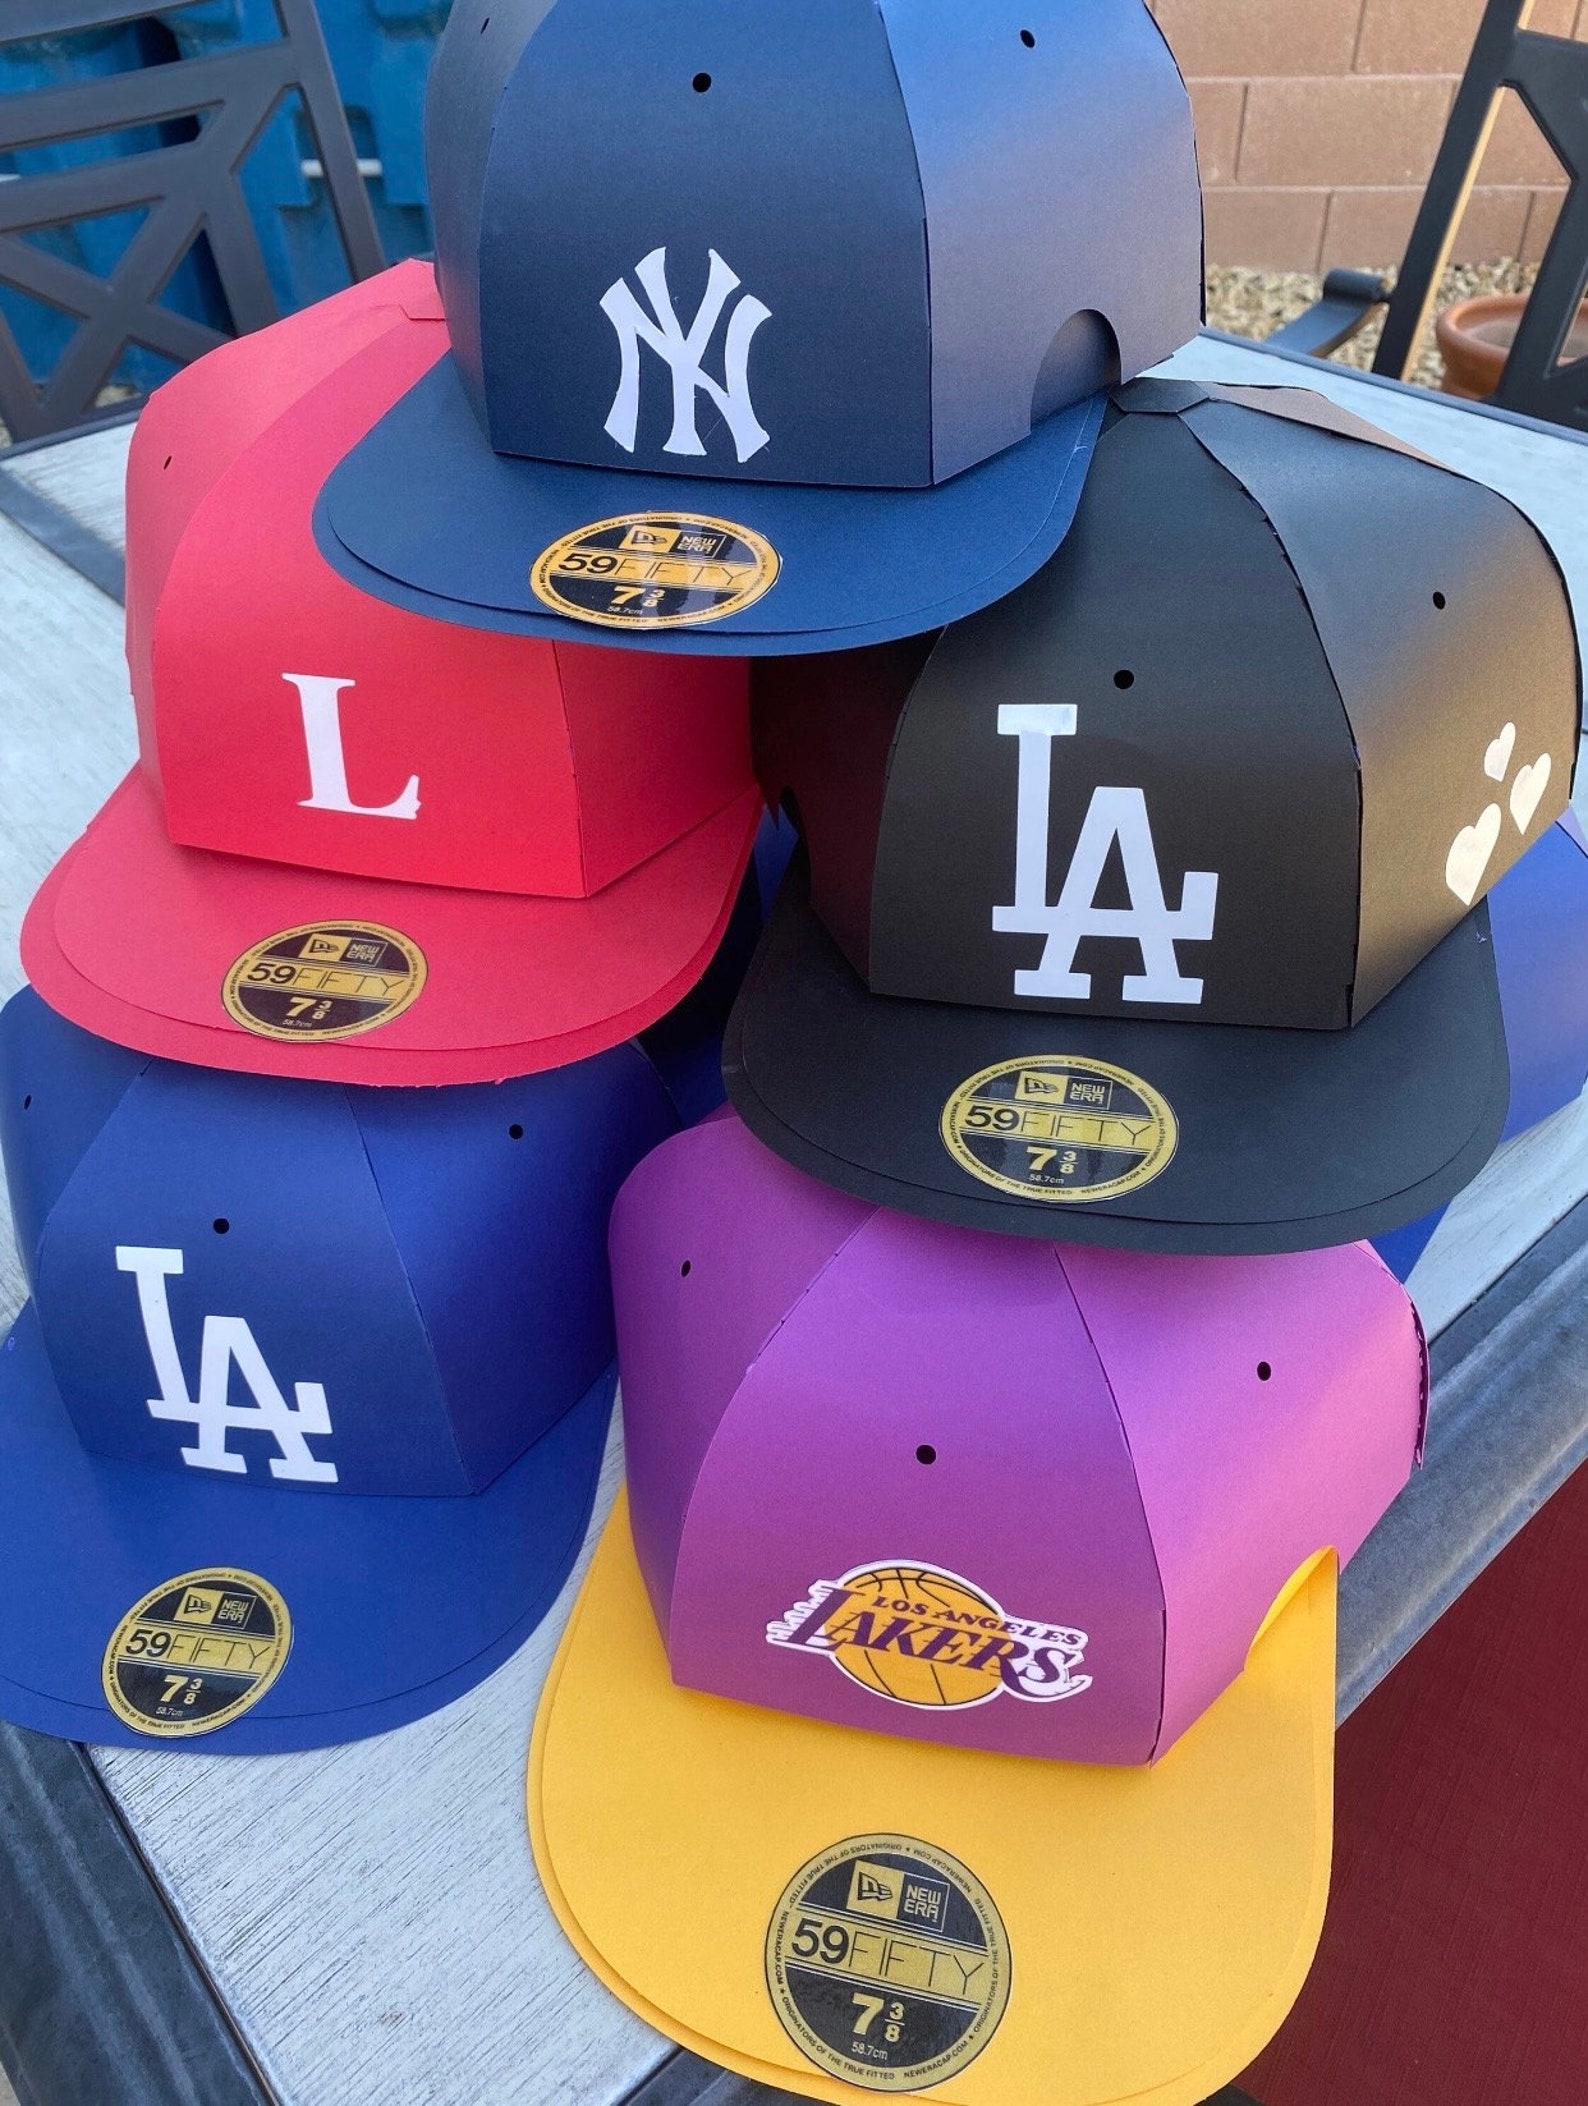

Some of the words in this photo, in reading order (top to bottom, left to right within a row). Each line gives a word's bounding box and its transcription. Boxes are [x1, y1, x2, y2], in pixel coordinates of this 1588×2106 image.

[678, 543, 713, 554] ERA
[680, 534, 718, 548] NEW
[611, 585, 646, 604] 7
[281, 672, 422, 820] L
[992, 704, 1219, 1004] LA
[346, 951, 375, 962] ERA
[350, 942, 380, 954] NEW
[285, 996, 318, 1017] 7
[1069, 1092, 1104, 1104] ERA
[1071, 1082, 1105, 1095] NEW
[1027, 1146, 1058, 1171] 7
[1029, 1174, 1065, 1185] 58.7cm
[115, 1245, 338, 1483] LA
[218, 1609, 244, 1621] ERA
[223, 1599, 249, 1611] NEW
[871, 1595, 930, 1616] LOS
[933, 1608, 1083, 1646] ANGELES
[786, 1585, 1089, 1697] LAKERS
[160, 1674, 190, 1702] 7
[913, 1849, 972, 1893] NEWERACAPCOM
[906, 1884, 942, 1905] NEW
[903, 1898, 939, 1920] ERA
[852, 1992, 885, 2035] 7
[851, 2041, 888, 2060] 58.7cm
[904, 2040, 969, 2078] NEWERACAPCOM
